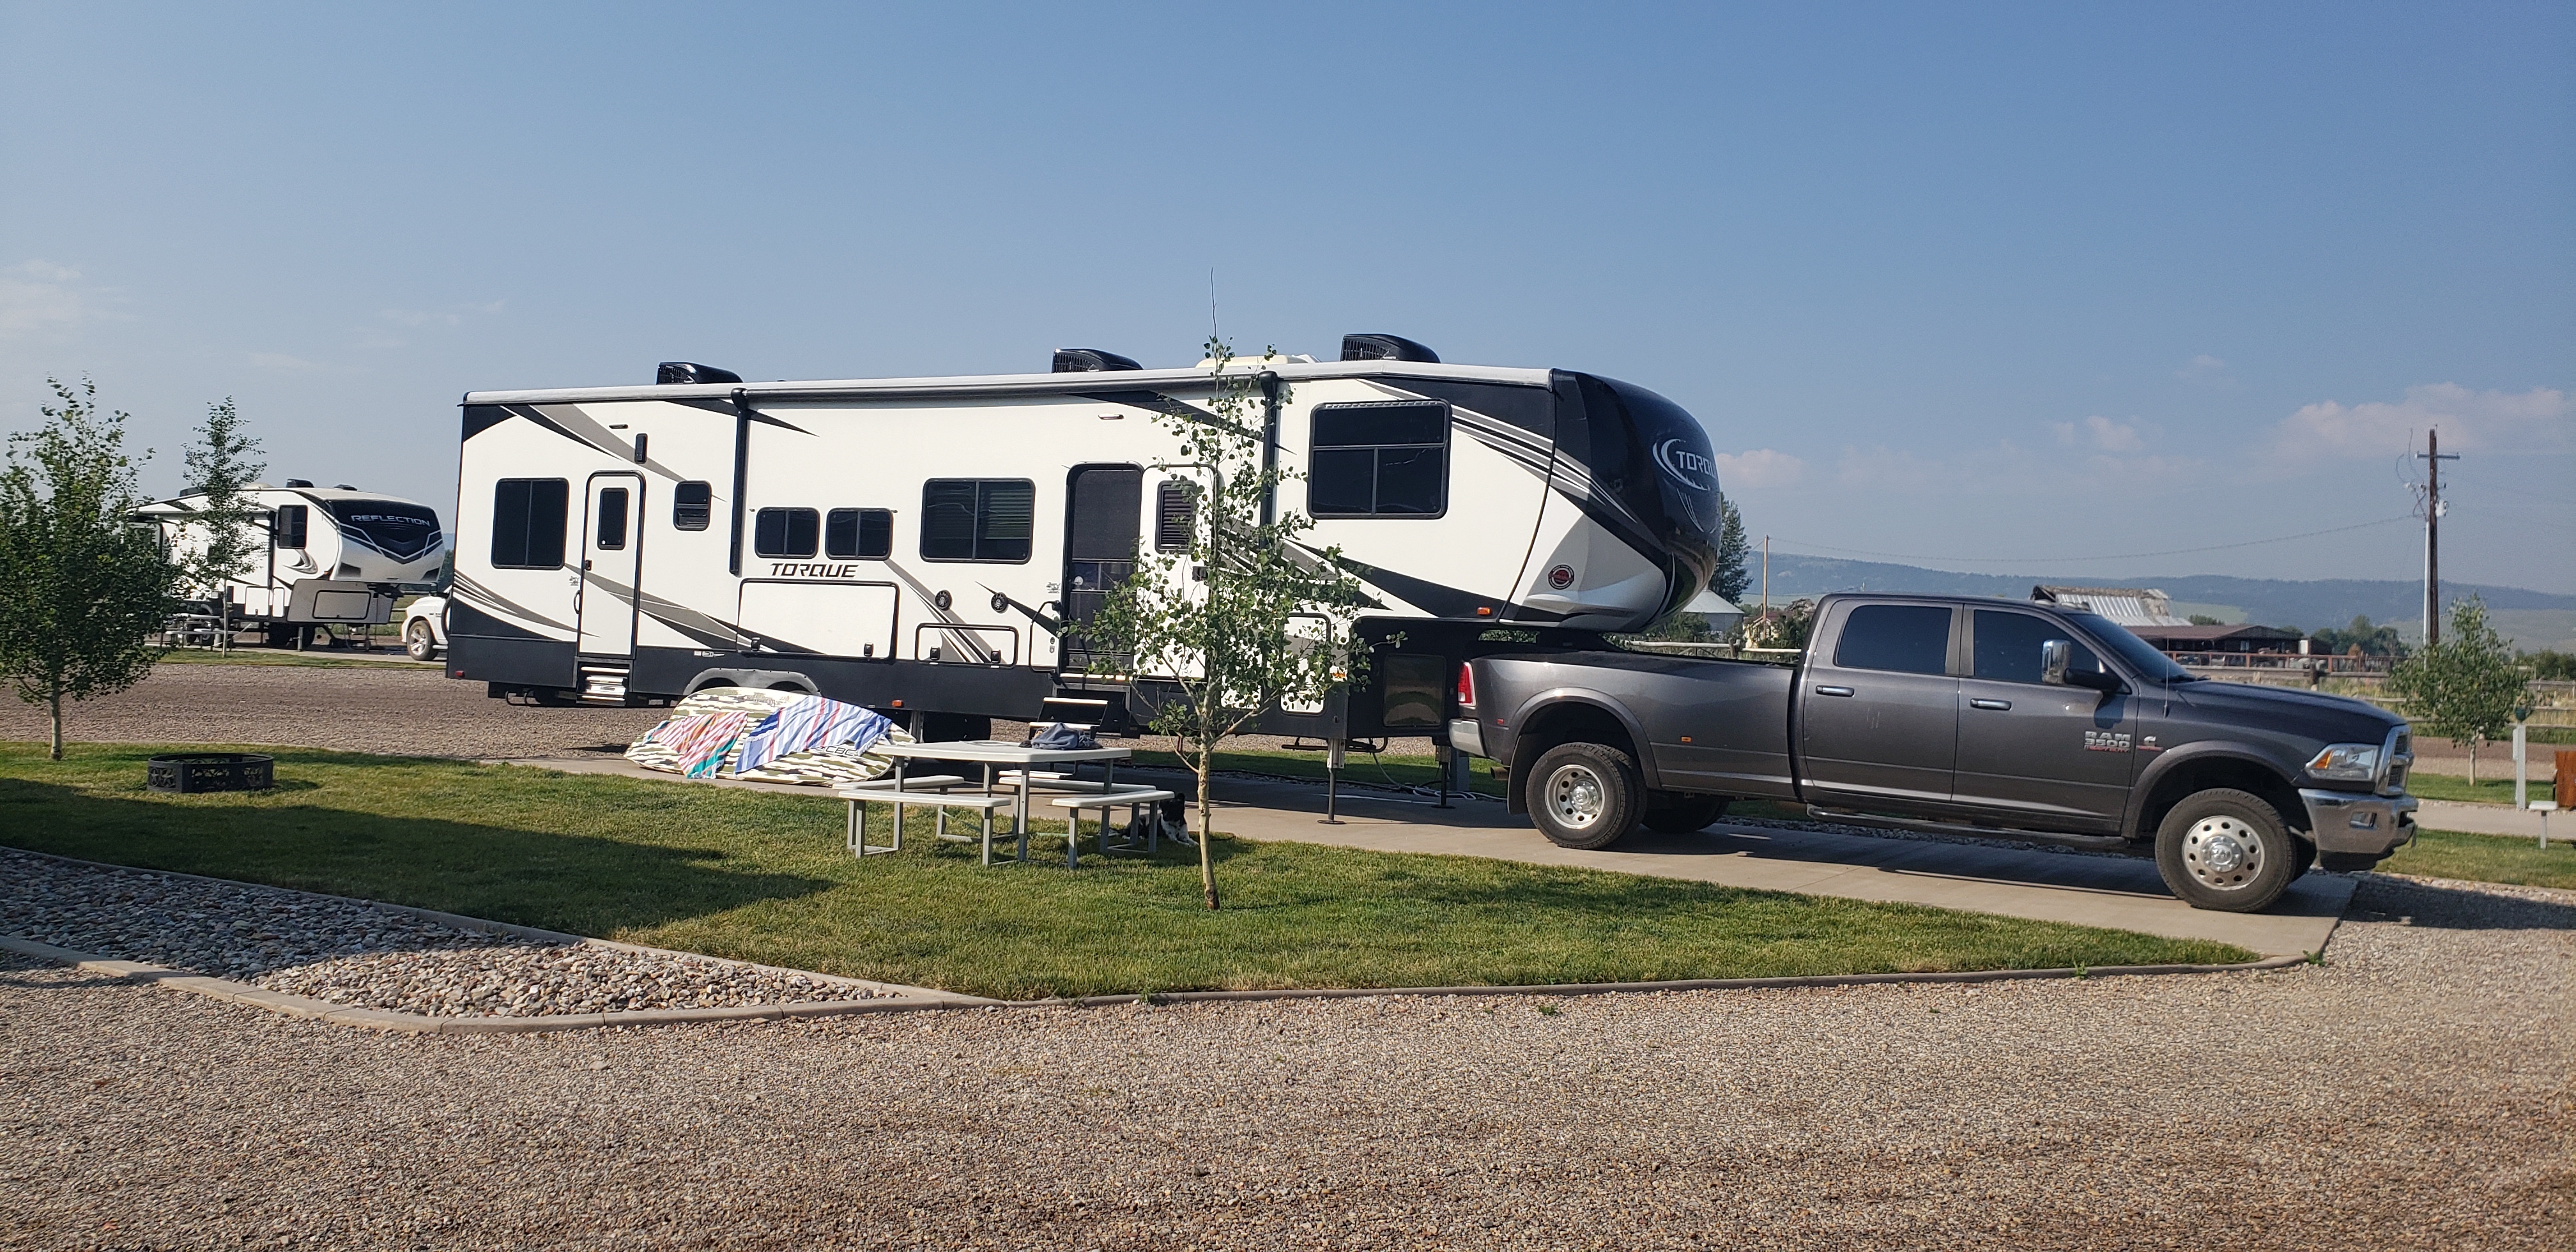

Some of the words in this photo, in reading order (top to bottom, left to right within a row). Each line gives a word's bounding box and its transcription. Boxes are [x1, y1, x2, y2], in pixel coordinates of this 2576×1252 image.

[1676, 450, 1718, 480] TORQU
[351, 515, 431, 527] REFLECTION
[770, 563, 860, 577] TORQUE
[2085, 731, 2131, 741] RAM
[2085, 738, 2130, 748] 3500
